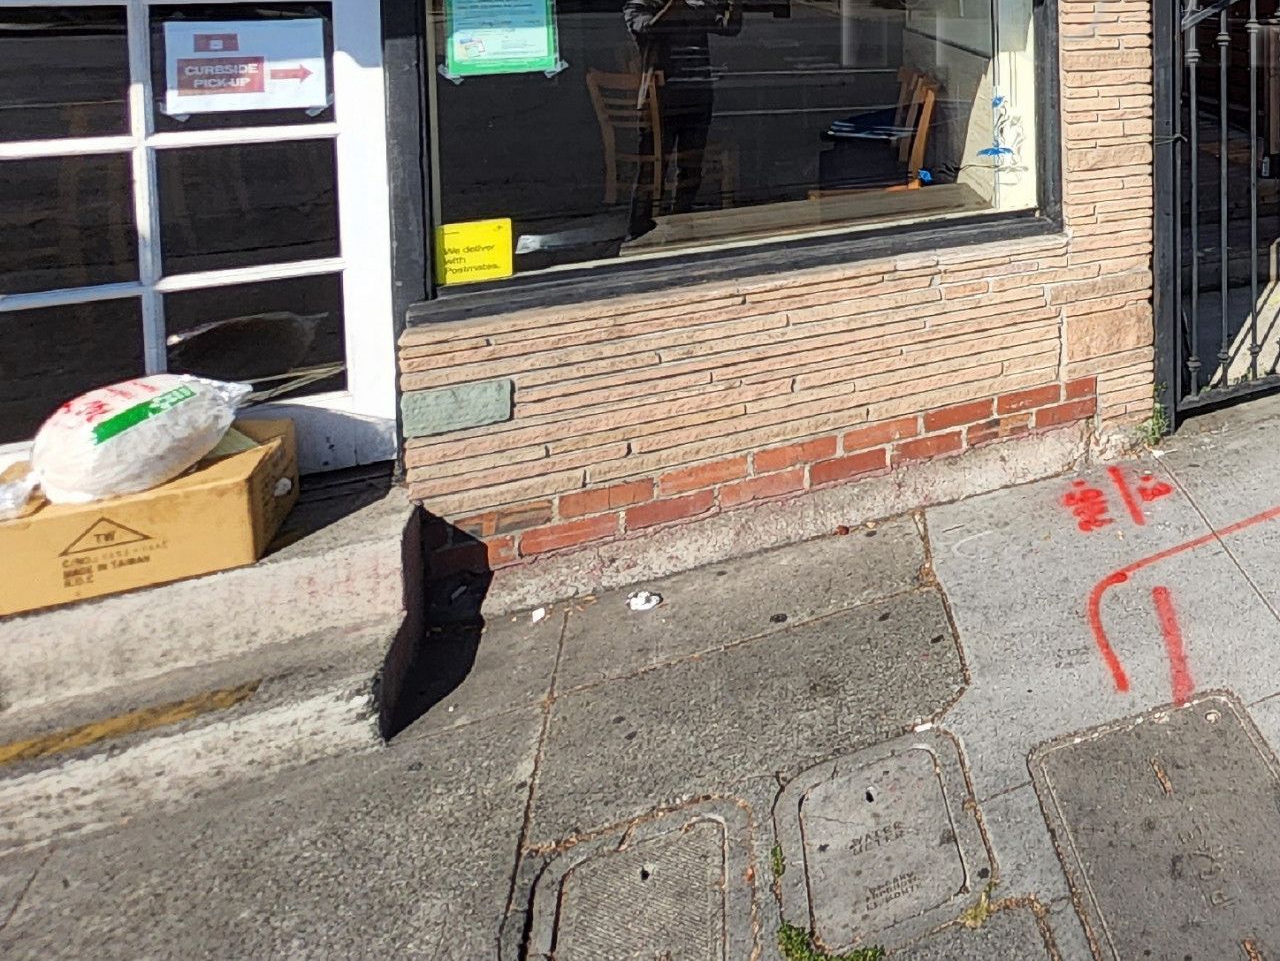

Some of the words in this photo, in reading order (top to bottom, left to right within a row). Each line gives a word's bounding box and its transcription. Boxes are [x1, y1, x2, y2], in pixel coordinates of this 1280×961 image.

[184, 63, 259, 75] CURBSIDE
[193, 77, 251, 88] PICK-UP
[463, 243, 496, 254] deliver
[444, 256, 466, 265] with
